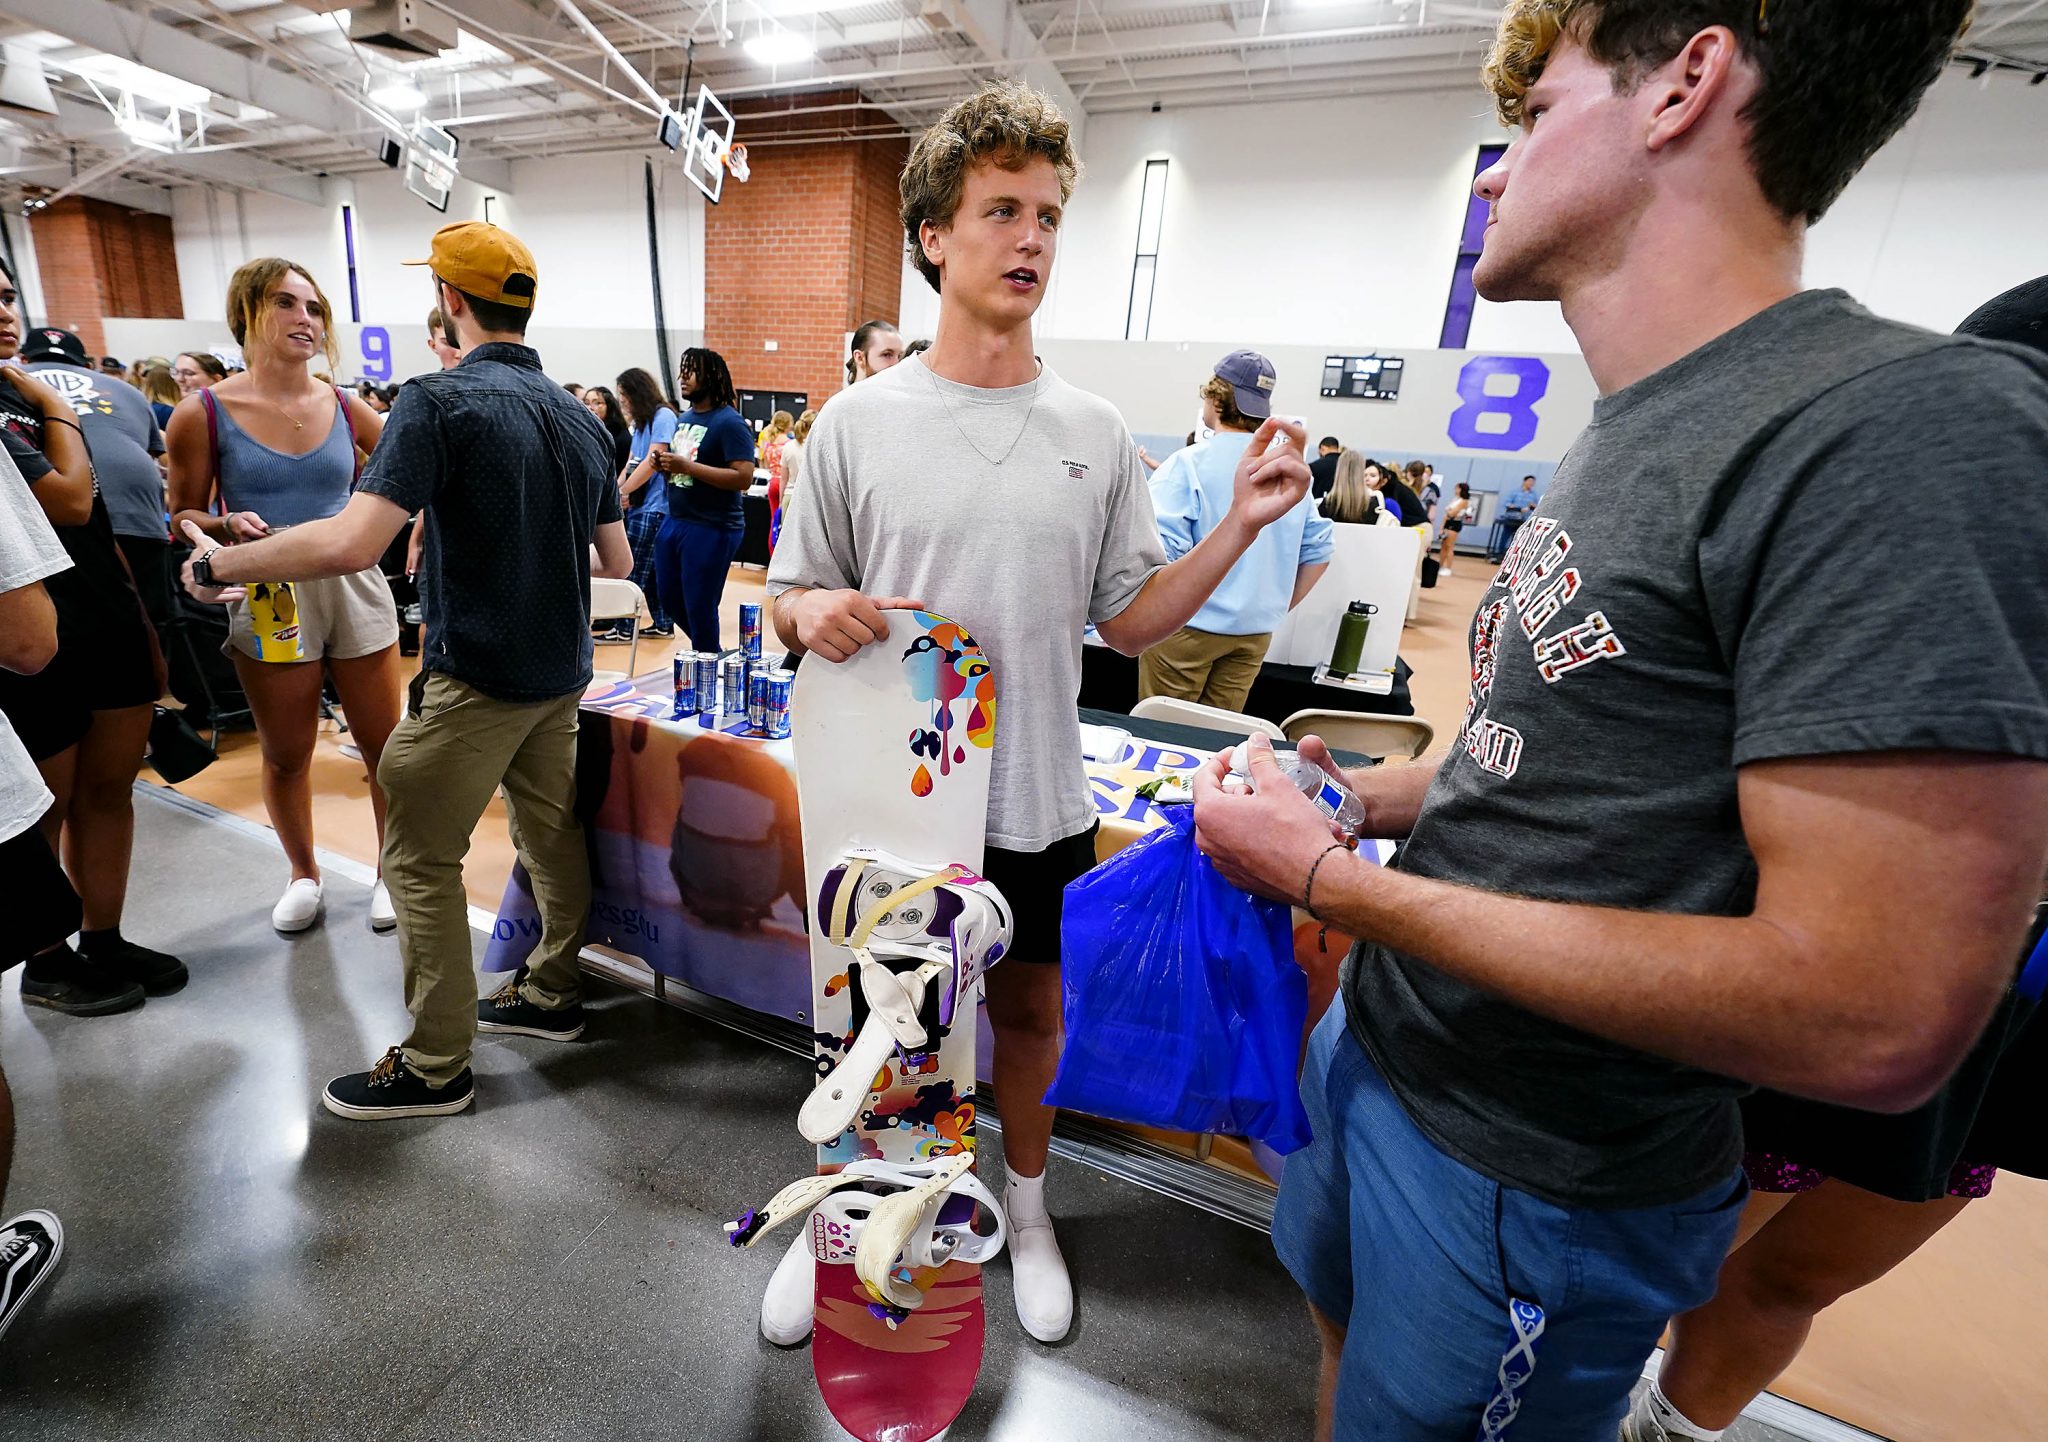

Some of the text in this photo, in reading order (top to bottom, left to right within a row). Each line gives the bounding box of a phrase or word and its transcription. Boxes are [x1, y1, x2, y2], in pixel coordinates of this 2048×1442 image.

[361, 327, 392, 381] 9
[1447, 356, 1550, 452] 8
[812, 1212, 829, 1261] MORROW
